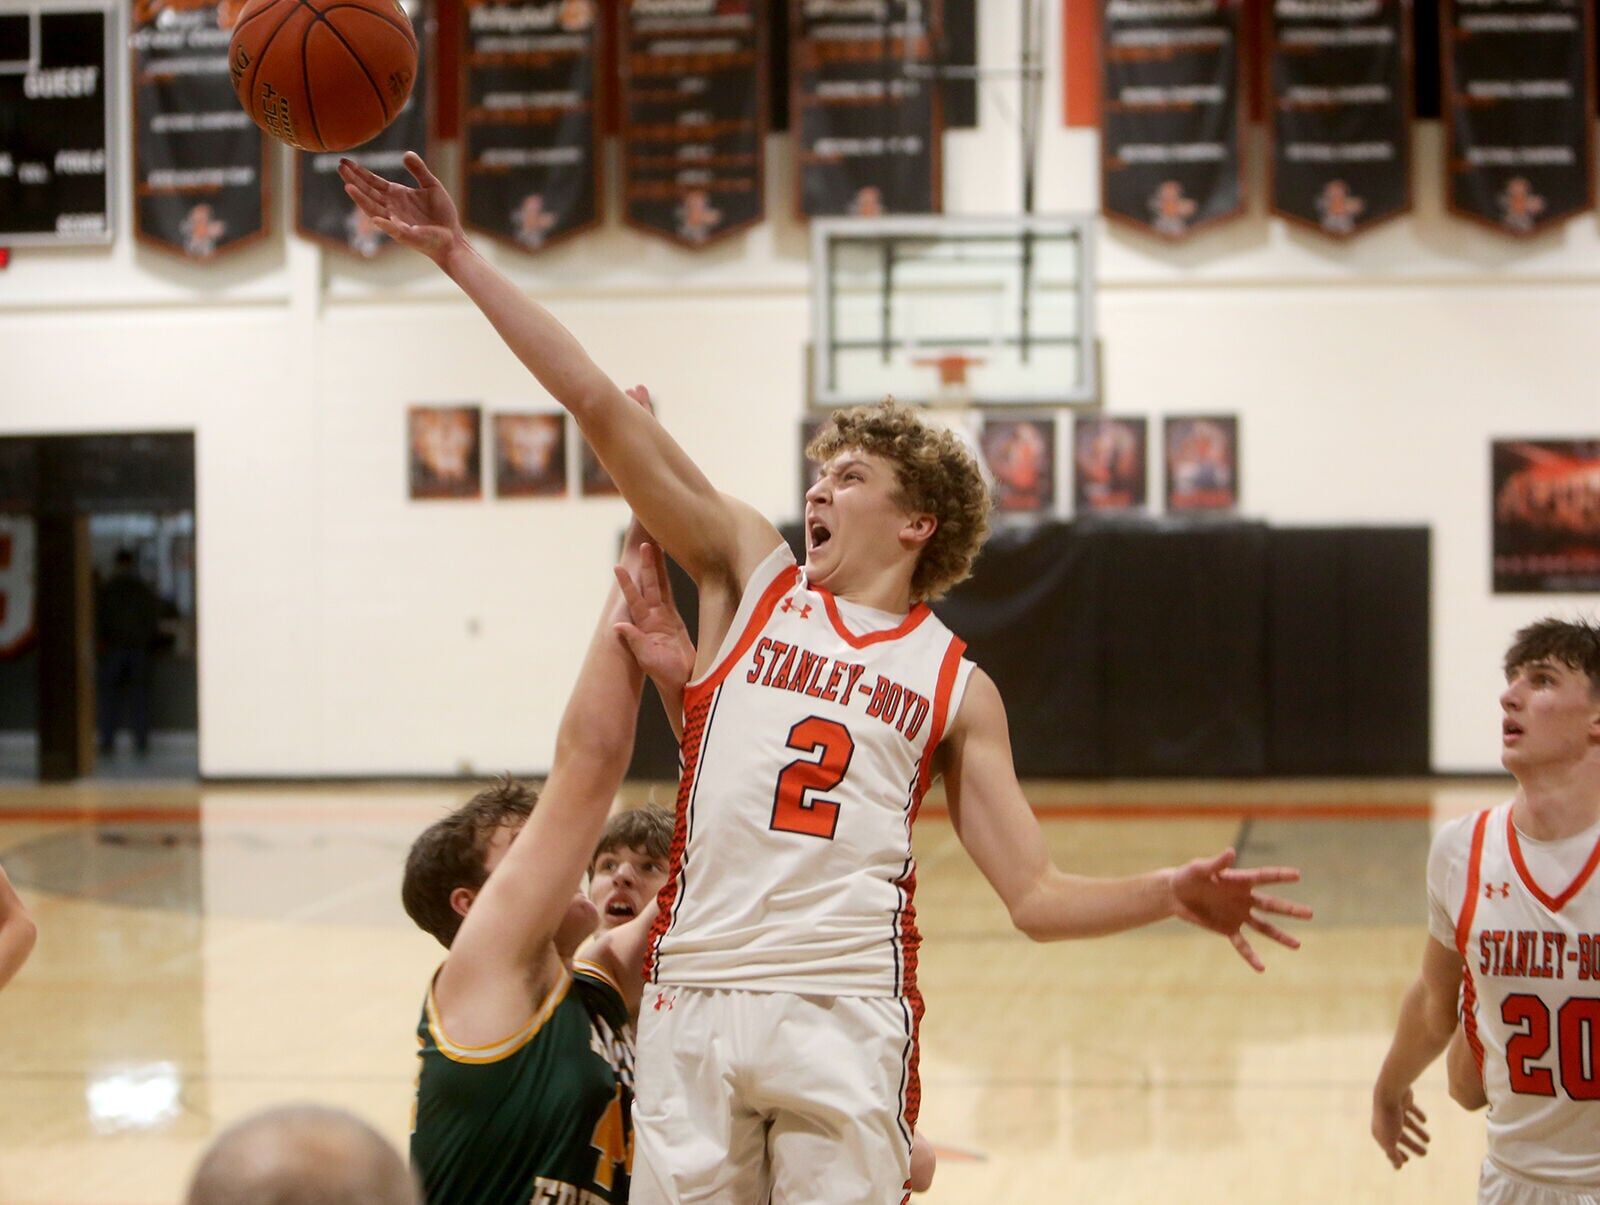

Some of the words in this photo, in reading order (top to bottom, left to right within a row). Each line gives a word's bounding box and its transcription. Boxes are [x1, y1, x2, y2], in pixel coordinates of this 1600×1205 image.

[24, 66, 97, 99] GUEST
[746, 636, 930, 742] STANLEY-BOYD
[769, 715, 855, 840] 2
[1501, 993, 1600, 1101] 20
